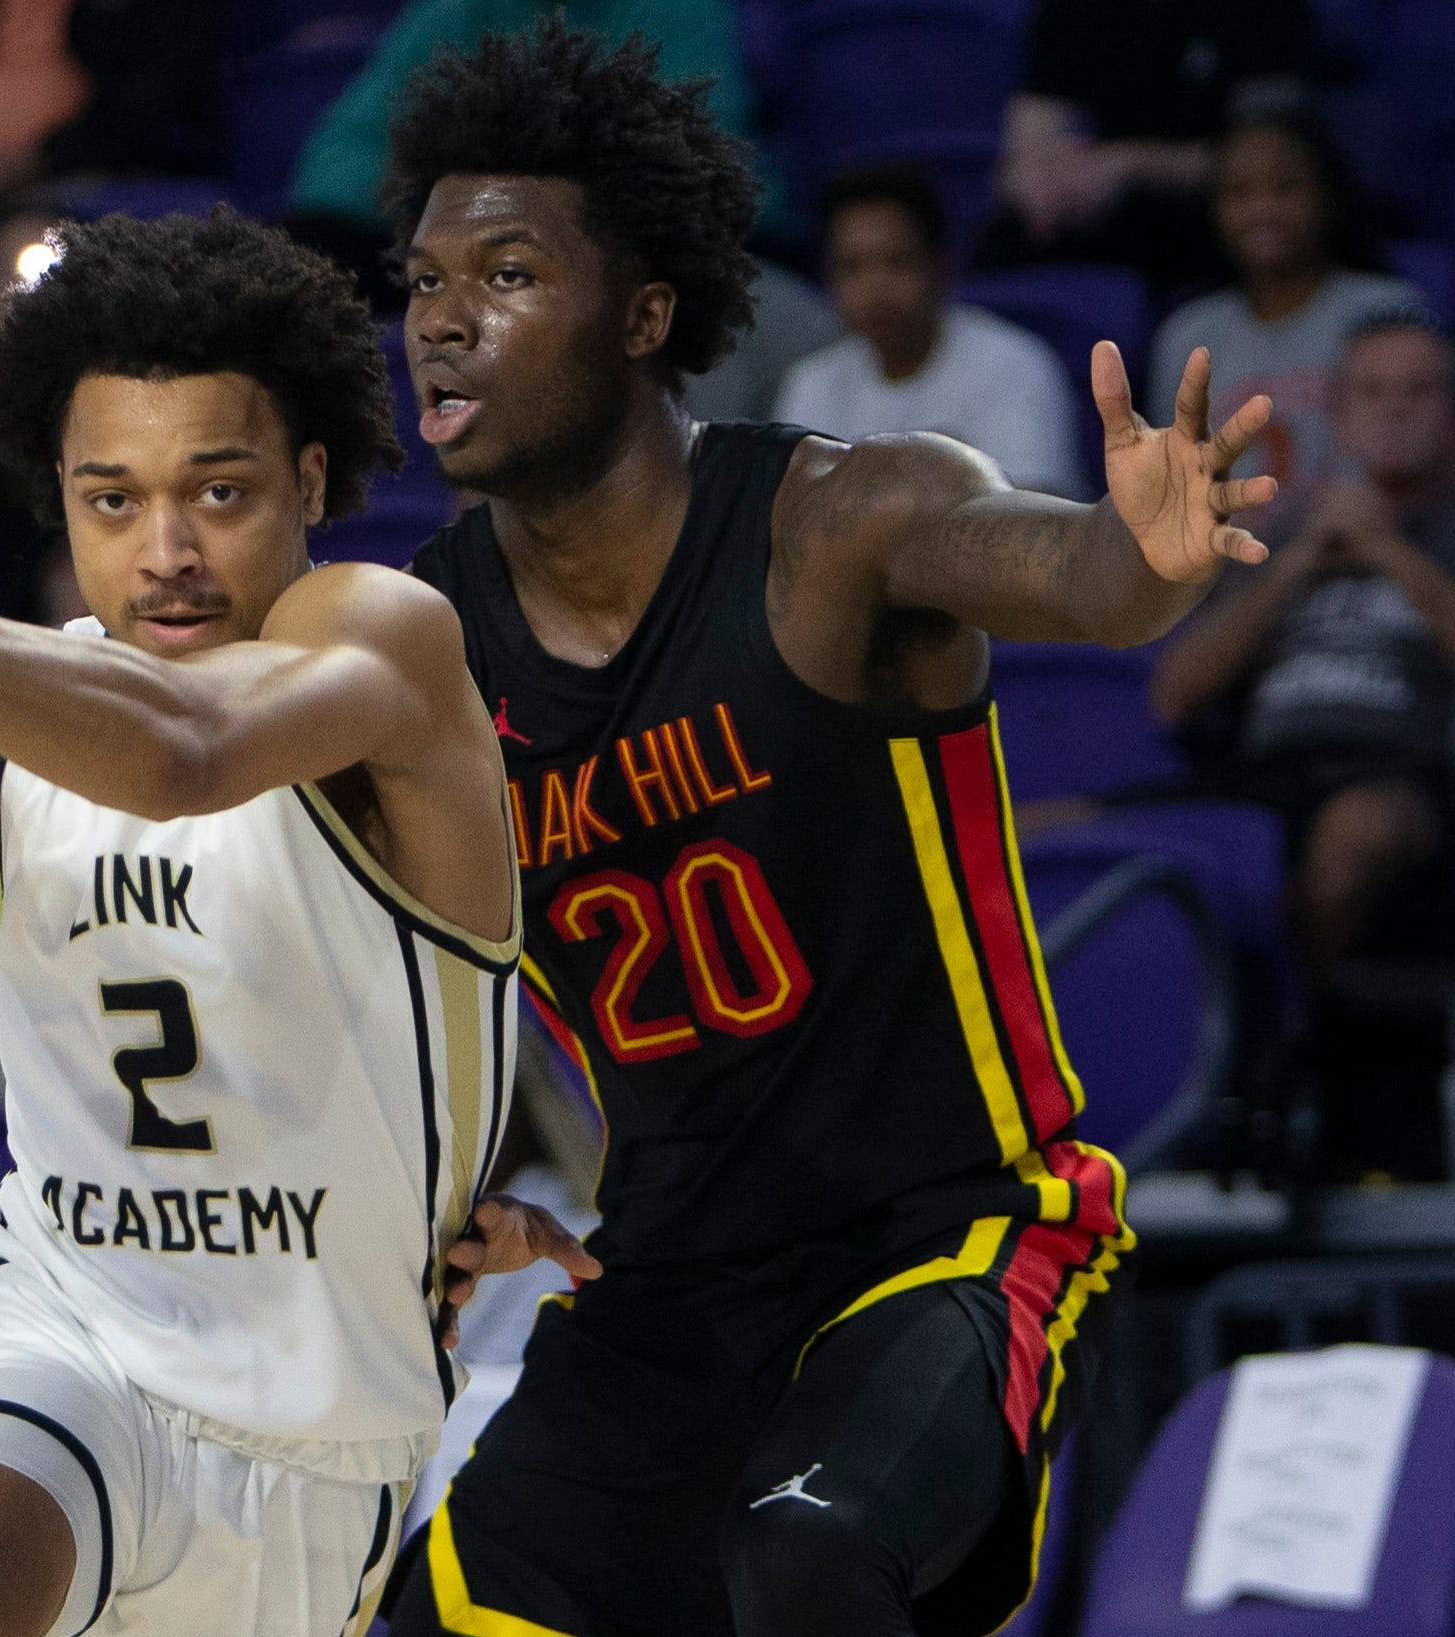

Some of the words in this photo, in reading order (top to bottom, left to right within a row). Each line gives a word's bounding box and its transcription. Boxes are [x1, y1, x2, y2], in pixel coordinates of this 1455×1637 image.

[615, 702, 772, 826] HILL
[548, 837, 815, 1064] 20
[98, 976, 219, 1156] 2
